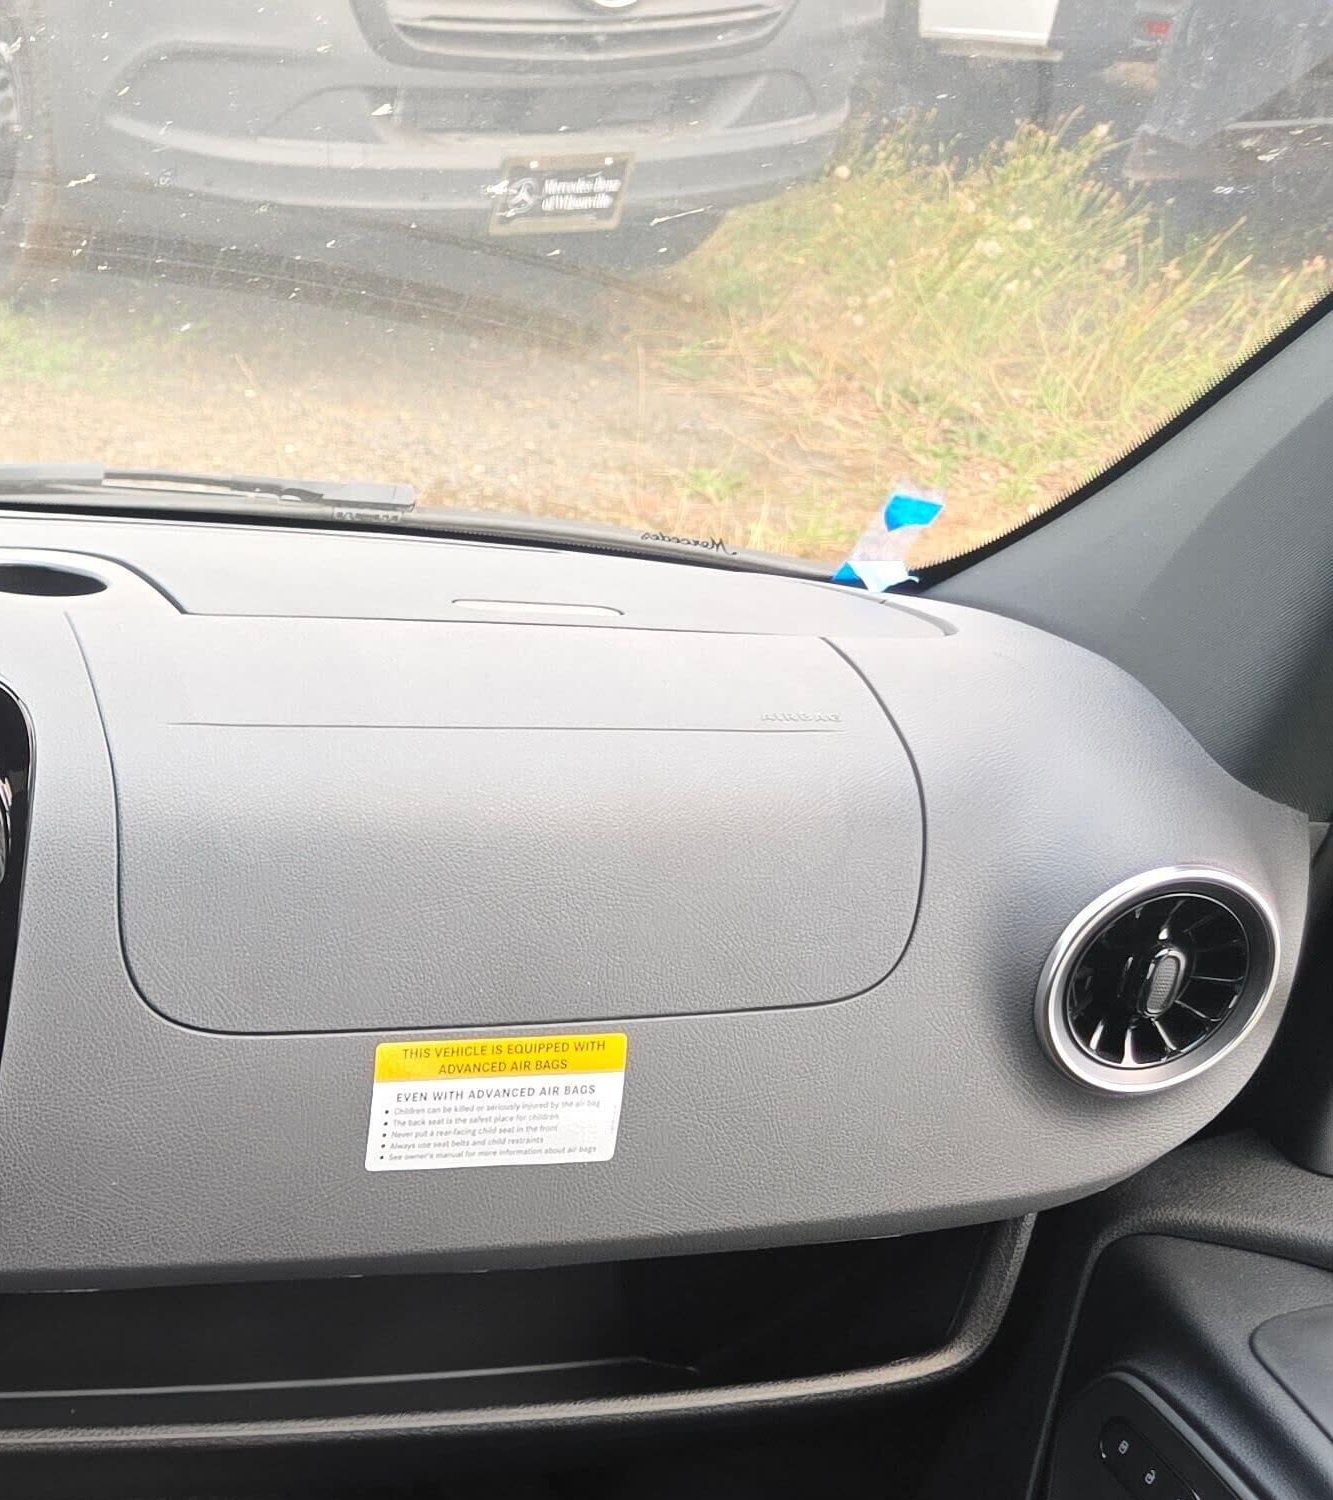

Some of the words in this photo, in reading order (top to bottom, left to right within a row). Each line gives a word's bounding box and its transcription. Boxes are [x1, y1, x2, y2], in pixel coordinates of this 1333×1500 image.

[403, 1048, 430, 1059] THIS
[434, 1045, 487, 1058] VEHICLE
[492, 1045, 502, 1055] IS
[507, 1042, 569, 1055] EQUIPPED
[573, 1040, 605, 1052] WITH
[438, 1062, 506, 1074] ADVANCED
[510, 1060, 531, 1071] AIR
[535, 1059, 567, 1070] BAGS
[396, 1092, 427, 1102] EVEN
[433, 1090, 463, 1101] WITH
[469, 1087, 535, 1099] ADVANCED
[539, 1086, 560, 1096] AIR
[564, 1085, 595, 1095] BAGS
